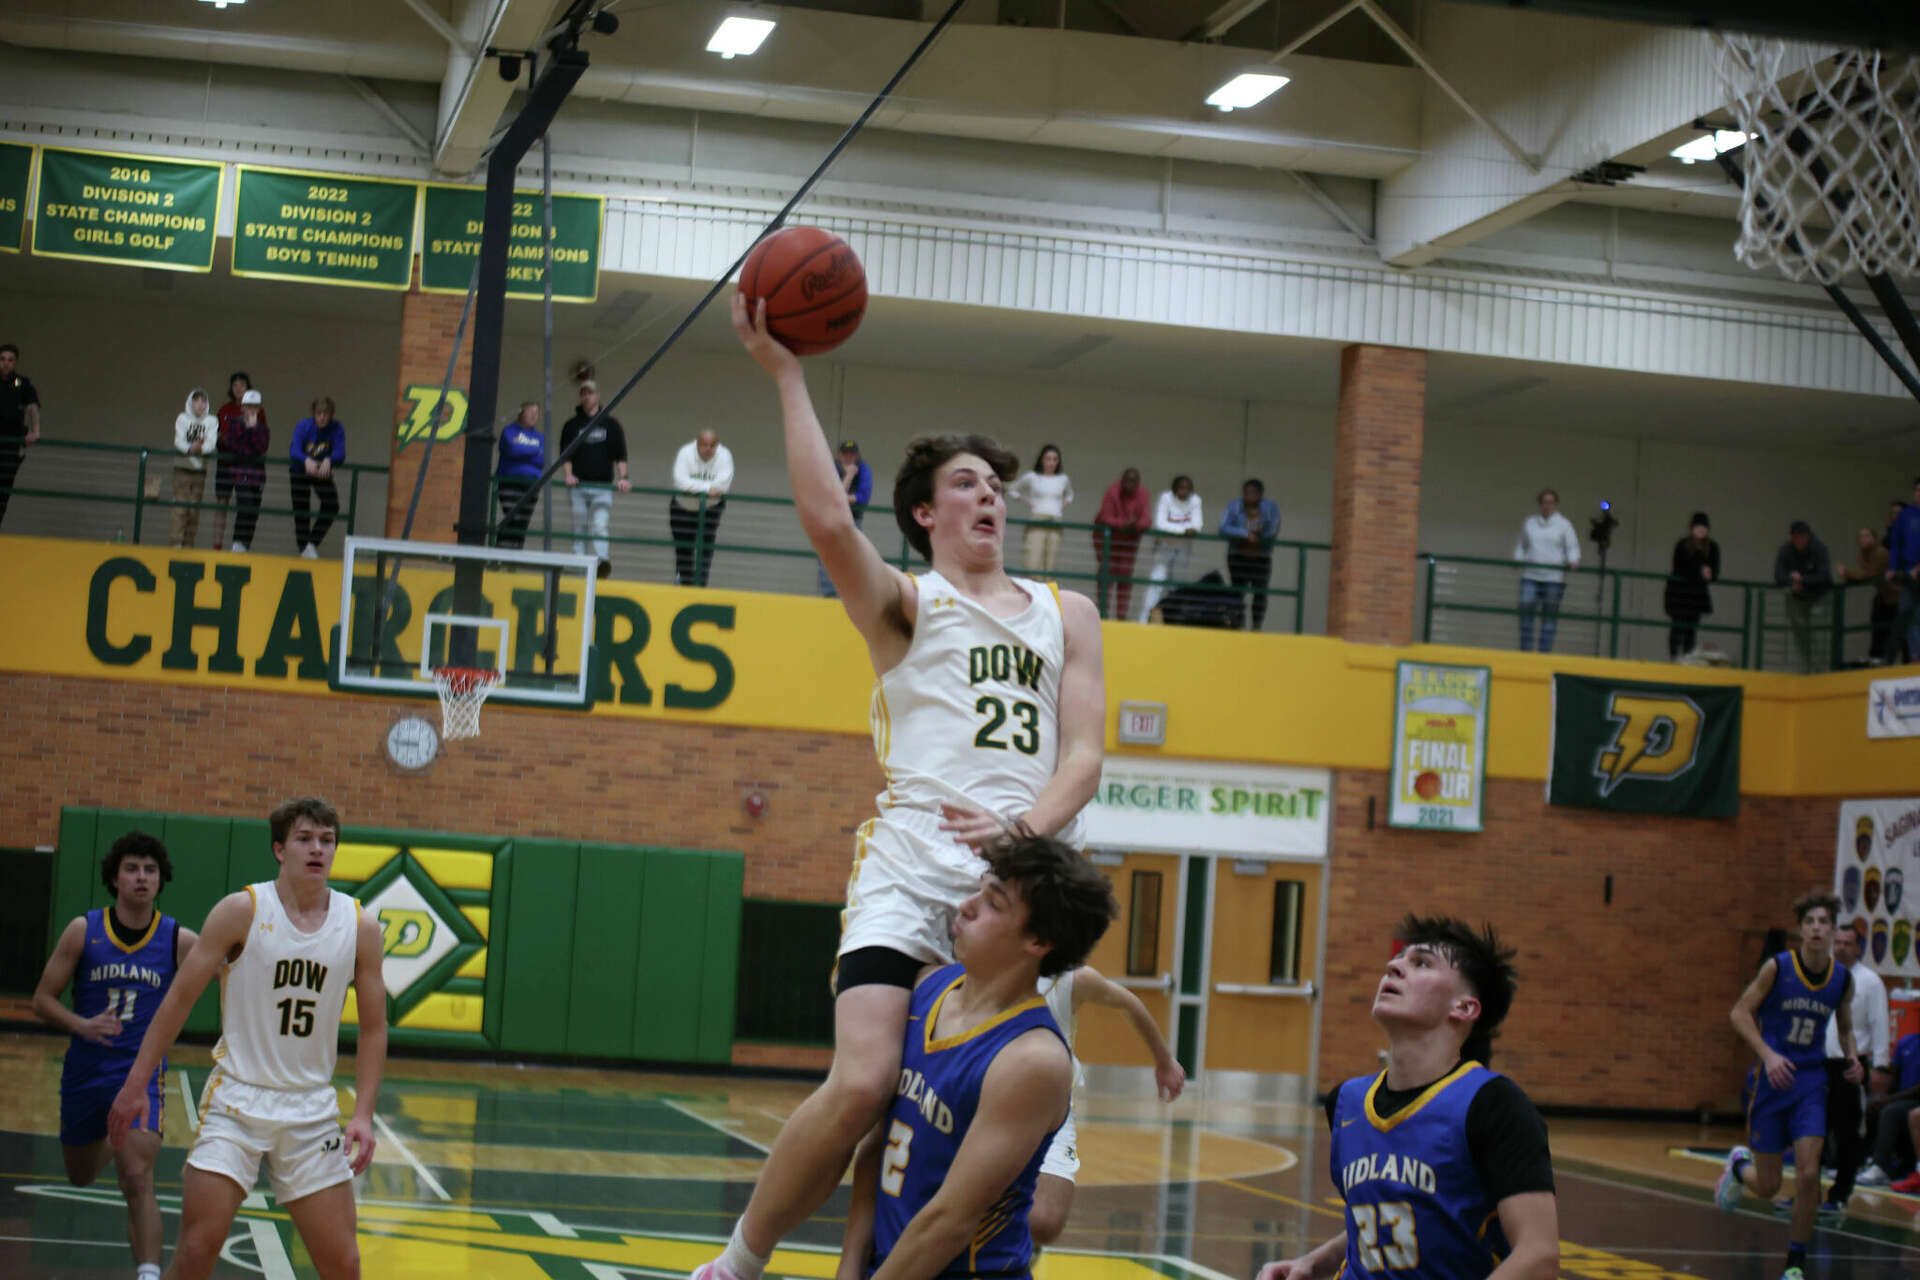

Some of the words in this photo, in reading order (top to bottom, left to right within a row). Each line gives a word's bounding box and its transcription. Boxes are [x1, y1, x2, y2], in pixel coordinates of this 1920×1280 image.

[110, 167, 150, 183] 2016
[83, 185, 159, 205] DIVISION
[163, 193, 175, 207] 2
[308, 185, 348, 202] 2022
[46, 204, 99, 221] STATE
[104, 209, 206, 232] CHAMPIONS
[281, 204, 357, 224] DIVISION
[361, 212, 372, 226] 2
[74, 227, 124, 245] GIRLS
[129, 233, 175, 250] GOLF
[245, 223, 297, 240] STATE
[302, 228, 403, 250] CHAMPIONS
[466, 220, 542, 239] DIION
[266, 246, 311, 263] BOYS
[315, 251, 379, 269] TENNIS
[432, 239, 482, 256] STATE
[508, 245, 589, 263] AMPONS
[86, 556, 736, 710] CHARGERS
[969, 644, 1044, 692] DOW
[974, 695, 1040, 756] 23
[1409, 740, 1472, 771] FINAL
[1092, 783, 1197, 812] RGER
[1210, 787, 1324, 820] SPIRIT
[1418, 806, 1454, 825] 2021
[90, 962, 161, 988] MIDLAND
[273, 958, 328, 993] DOW
[107, 987, 138, 1021] 11
[277, 997, 316, 1038] 15
[1787, 1016, 1816, 1045] 12
[881, 1117, 914, 1198] 2
[1352, 1201, 1420, 1273] 23
